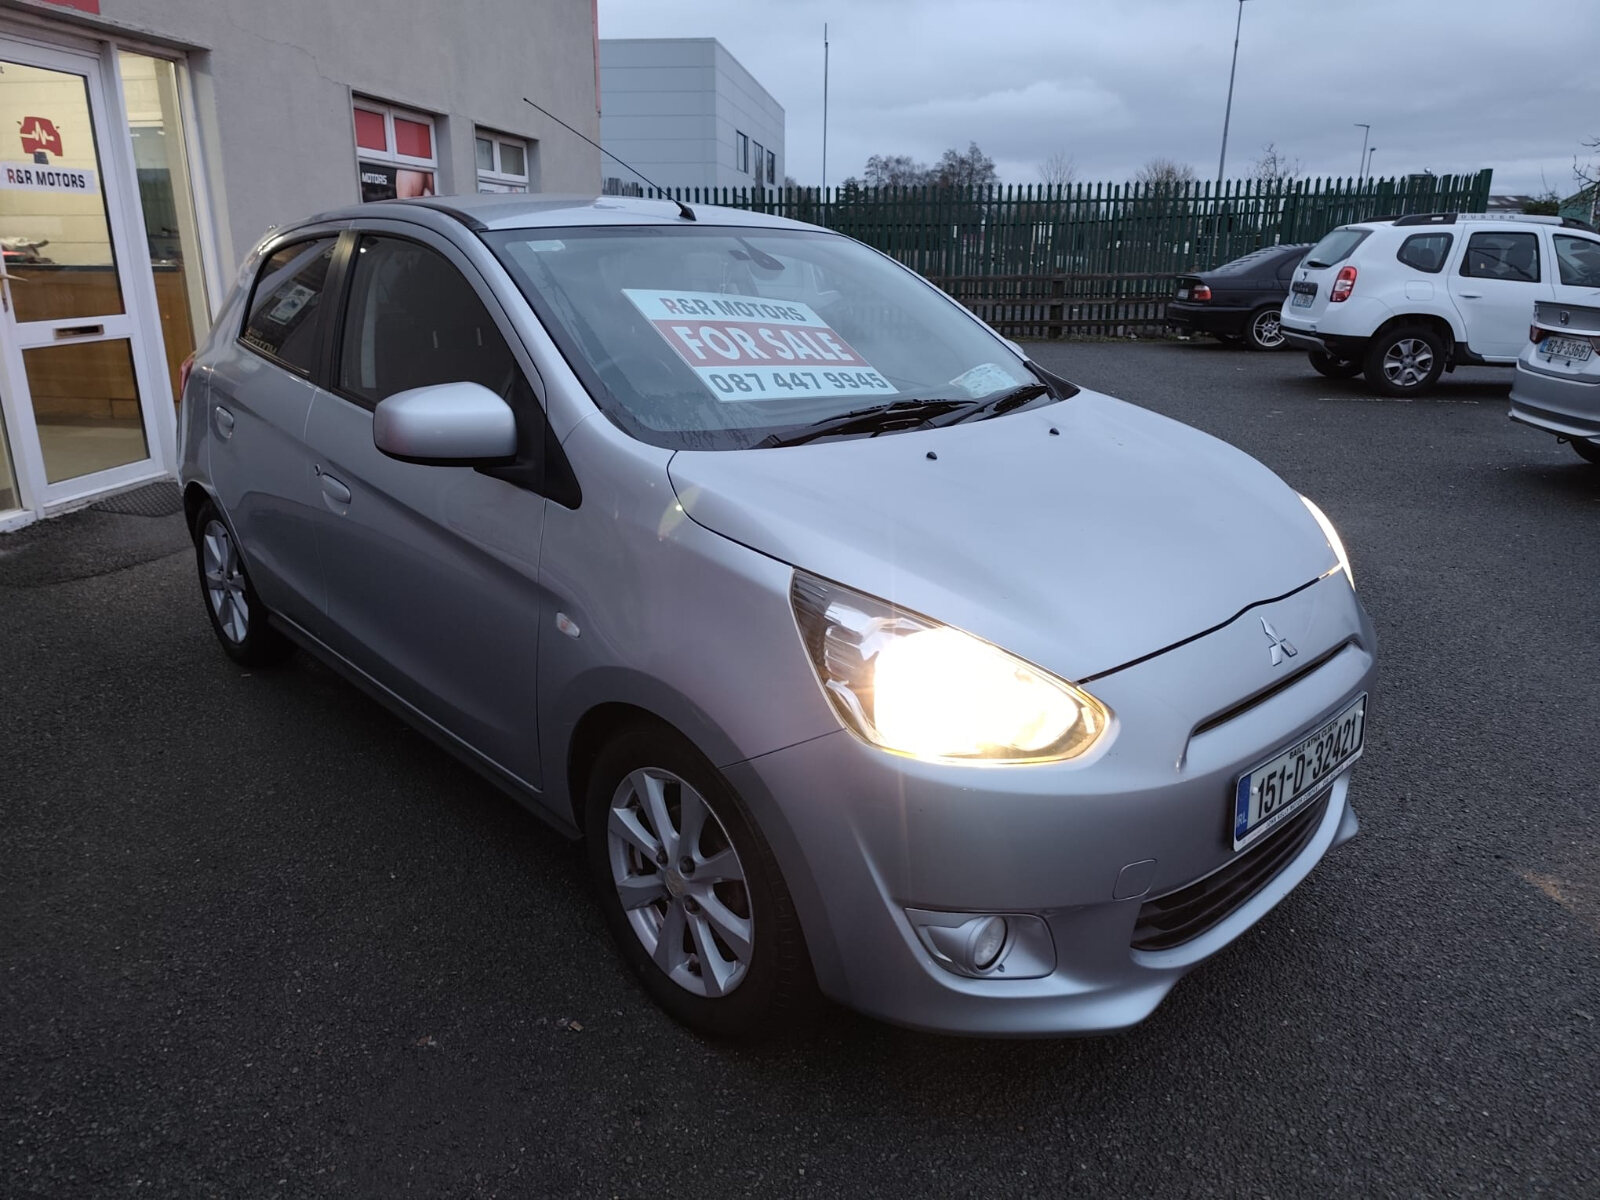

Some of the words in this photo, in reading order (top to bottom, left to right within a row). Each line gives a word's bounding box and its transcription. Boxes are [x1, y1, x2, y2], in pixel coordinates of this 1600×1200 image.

[6, 168, 33, 184] R&R
[36, 171, 86, 188] MOTORS
[361, 172, 388, 185] MOTORS
[659, 297, 715, 317] R&R
[719, 300, 807, 322] MOTORS
[671, 325, 771, 361] FOR
[758, 327, 855, 361] SALE
[709, 372, 766, 393] 087
[773, 372, 823, 390] 447
[823, 371, 889, 389] 9945
[1289, 743, 1305, 759] BAILE
[1307, 732, 1321, 748] ATHA
[1322, 720, 1339, 738] CLIATH
[1257, 712, 1357, 819] 151-D-32421
